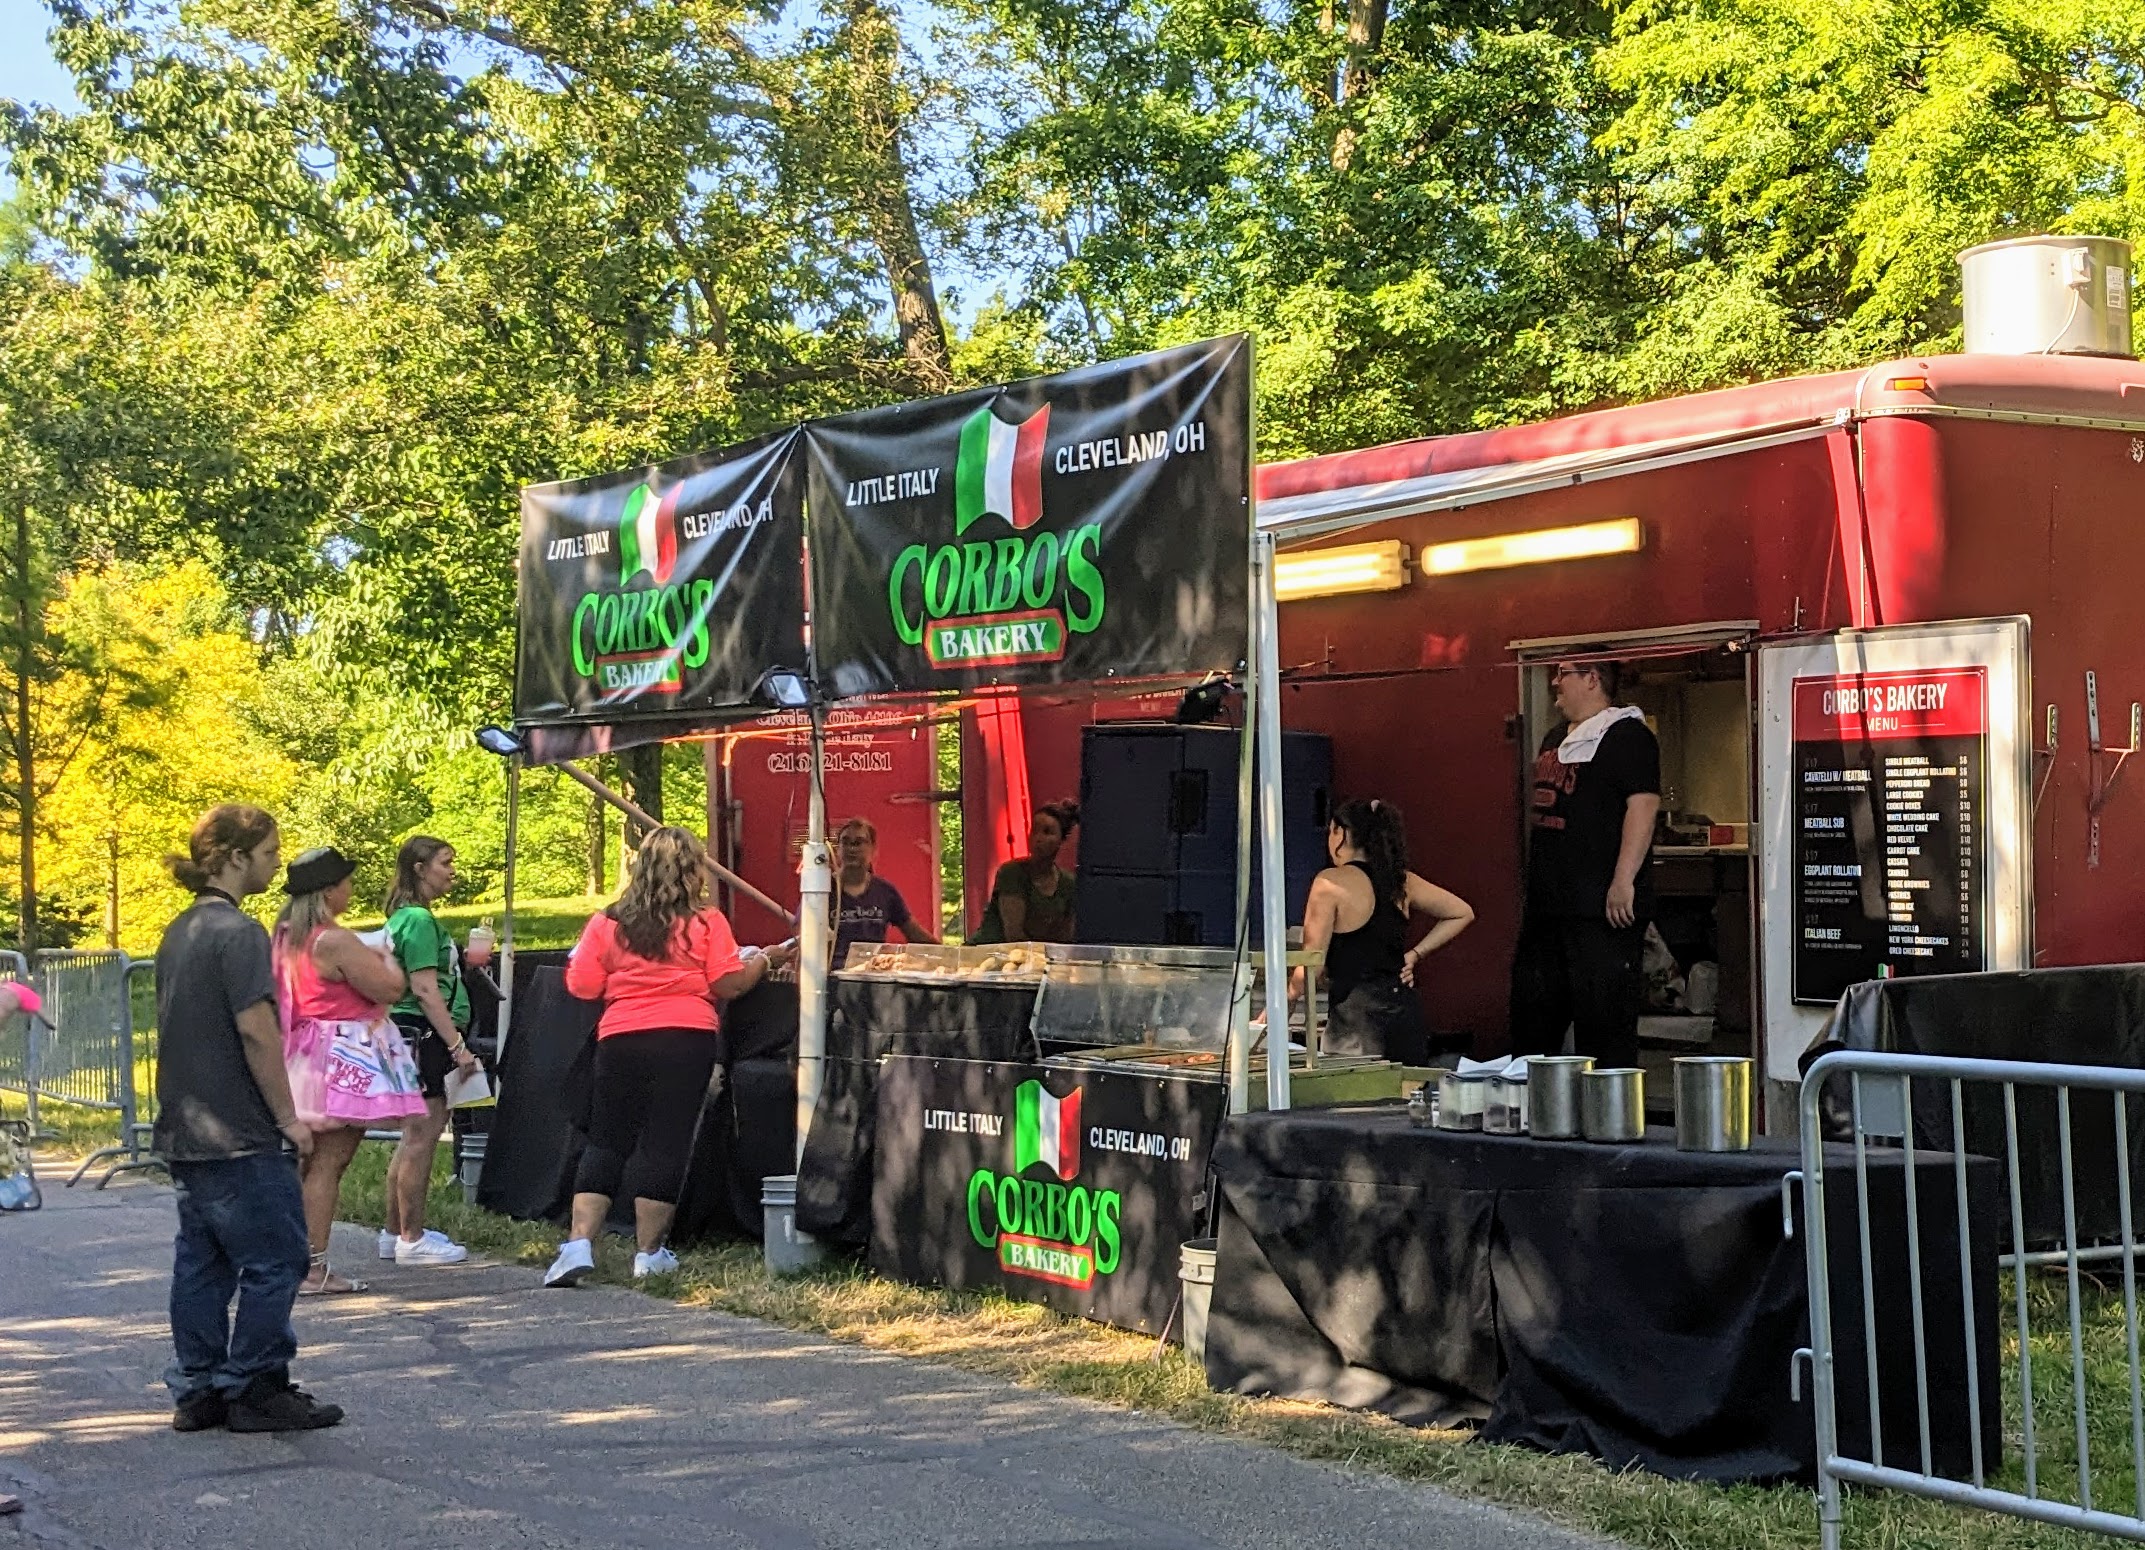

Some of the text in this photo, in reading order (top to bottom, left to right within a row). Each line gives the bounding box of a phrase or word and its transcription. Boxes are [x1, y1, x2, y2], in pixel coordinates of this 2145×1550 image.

[1055, 422, 1205, 475] CLEVELAND, OH
[846, 468, 940, 506] LITTLE ITALY
[547, 530, 610, 561] LITTLE ITALY
[889, 522, 1106, 646] CORBO'S
[572, 578, 714, 678] CORBO'S
[940, 621, 1048, 660] BAKERY
[1823, 683, 1948, 716] CORBO'S BAKERY
[1866, 717, 1899, 732] MENU
[1843, 769, 1873, 782] MEATBALL
[1960, 789, 1968, 798] $5
[1960, 801, 1971, 811] $10
[1804, 816, 1845, 829] MEATBALL SUB
[1960, 812, 1971, 821] $10
[1960, 824, 1971, 833] $10
[1804, 864, 1832, 876] EGGPLANT
[1804, 927, 1842, 940] ITALIAN BEEF
[924, 1109, 1004, 1136] LITTLE ITALY
[1090, 1126, 1191, 1162] CLEVELAND, OH
[967, 1169, 1121, 1275] CORBO'S
[1011, 1244, 1084, 1282] BAKERY
